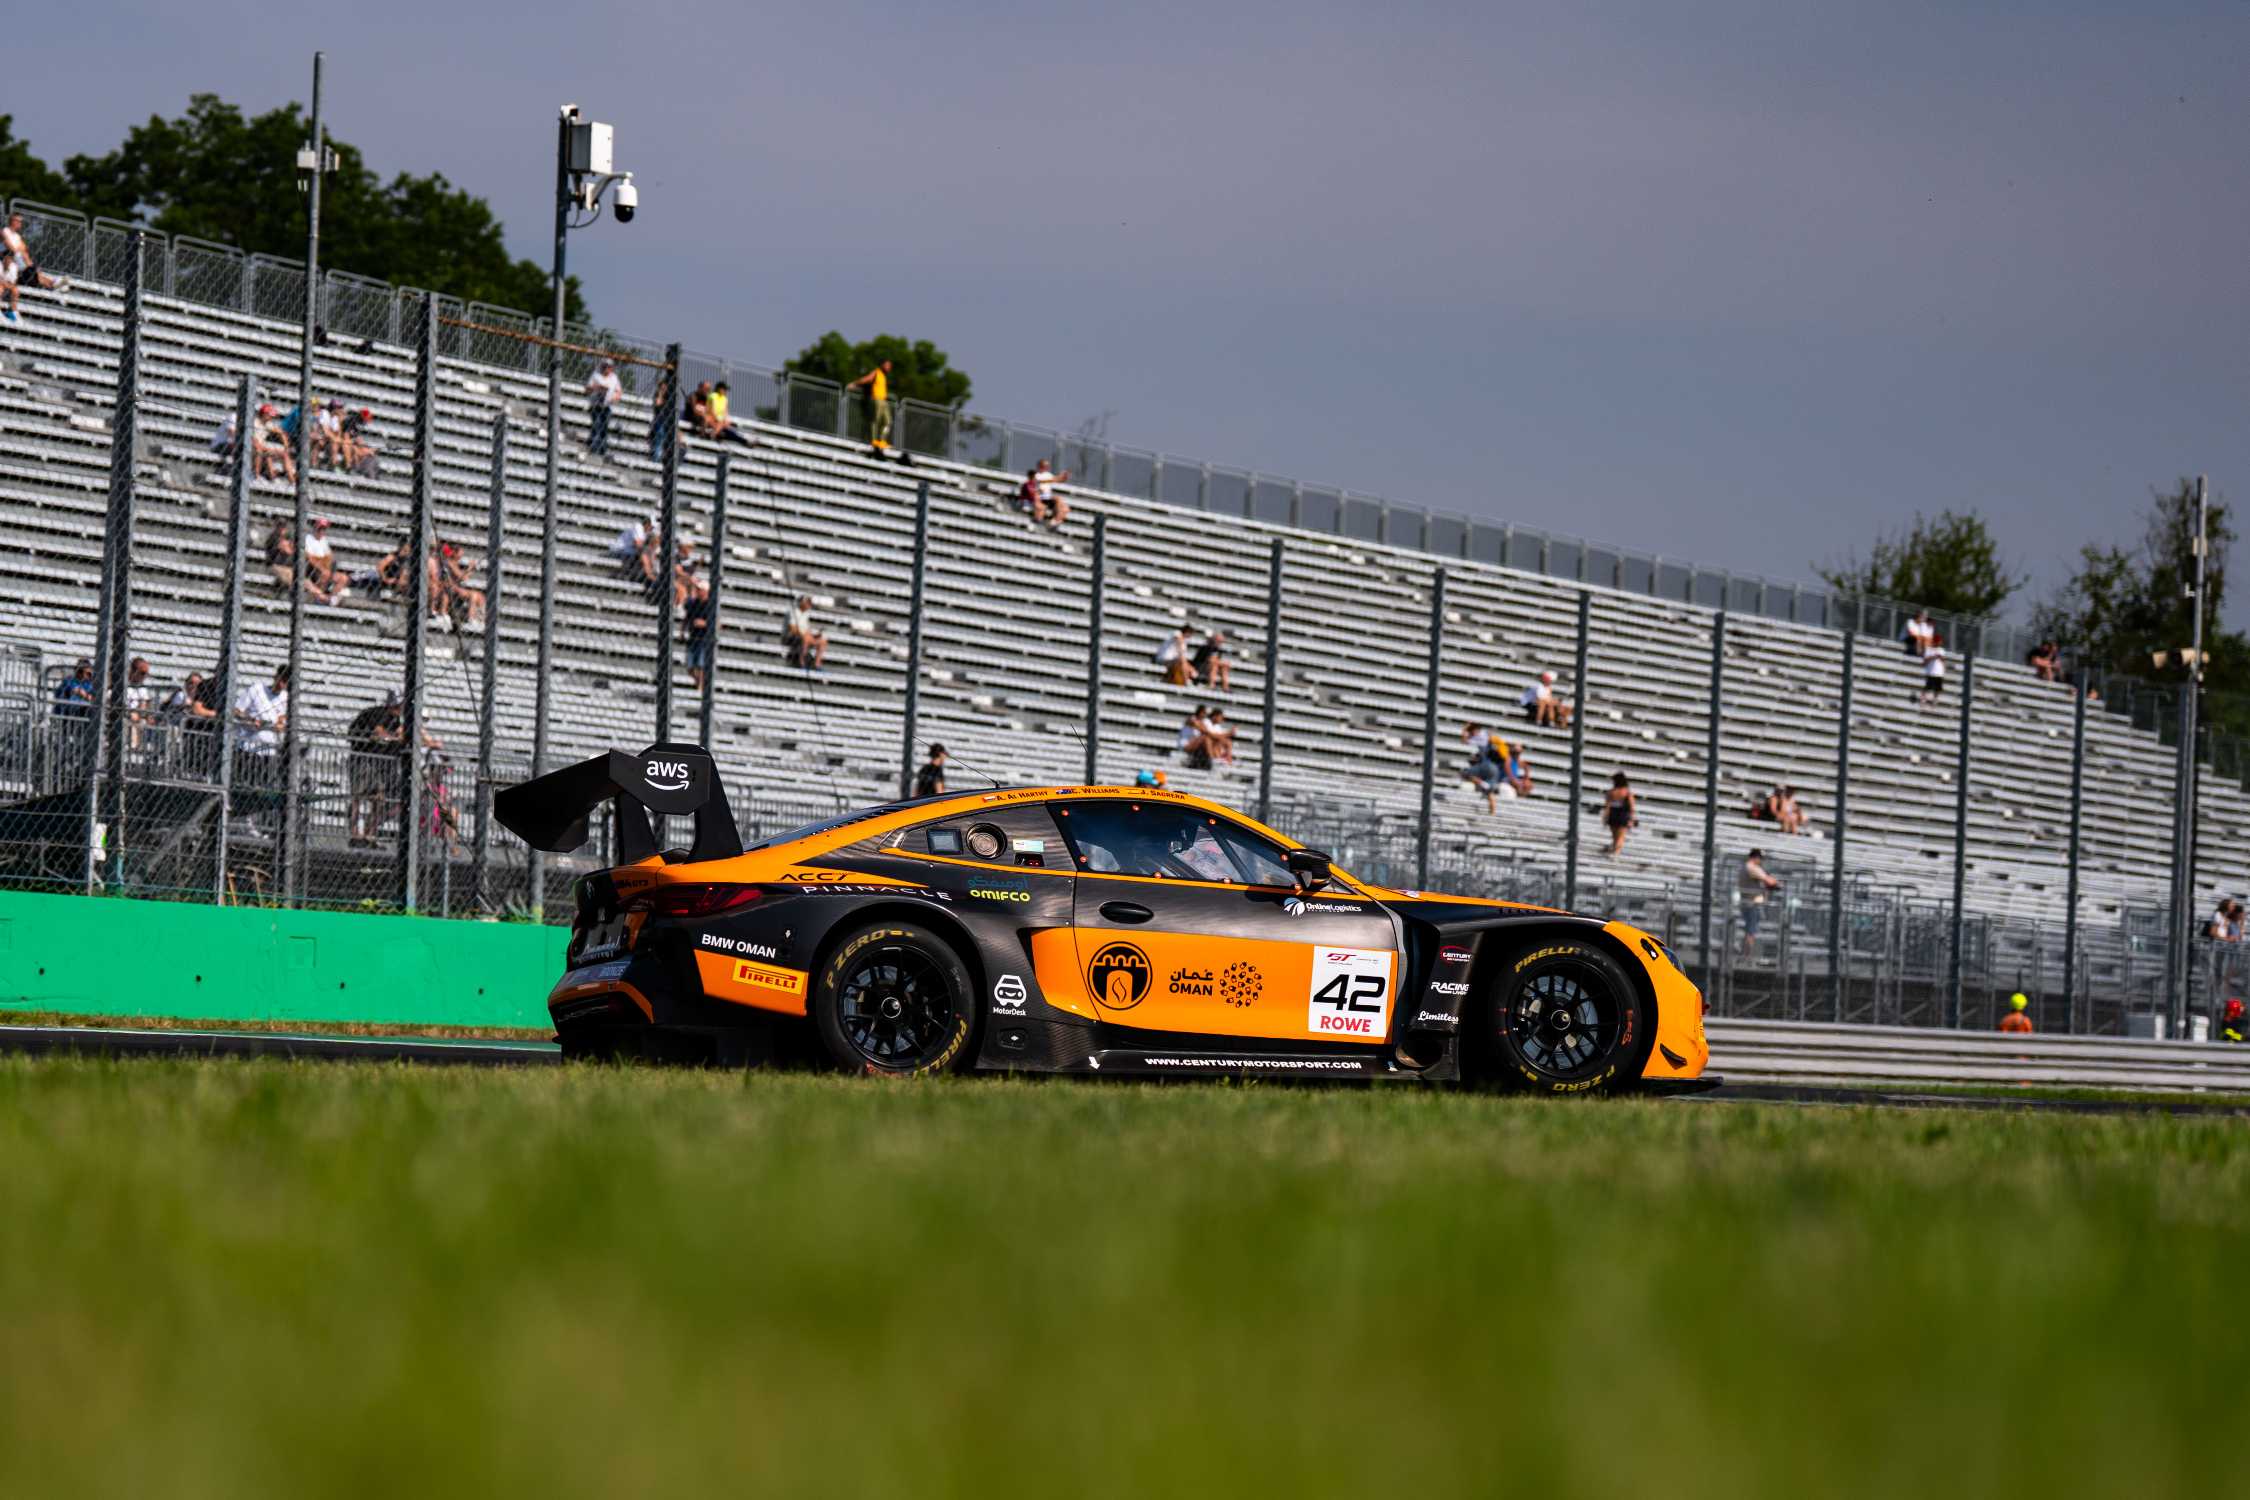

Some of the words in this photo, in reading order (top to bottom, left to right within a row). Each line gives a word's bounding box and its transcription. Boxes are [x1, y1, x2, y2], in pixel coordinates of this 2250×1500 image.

[646, 760, 688, 779] aws
[802, 884, 953, 901] PINNACLE
[701, 933, 735, 950] BMW
[736, 941, 776, 959] OMAN
[834, 929, 886, 971] ZERO
[1514, 946, 1577, 973] PIRELLI
[739, 965, 798, 989] PIRELLI
[1169, 982, 1213, 996] OMAN
[1312, 974, 1386, 1014] 42
[1431, 981, 1469, 993] RACING
[993, 1006, 1026, 1016] MotorDesk
[1320, 1015, 1372, 1032] ROWE
[1145, 1058, 1362, 1069] WWW.CENTURYMOTORSPORT.COM
[1552, 1074, 1602, 1092] ZERO
